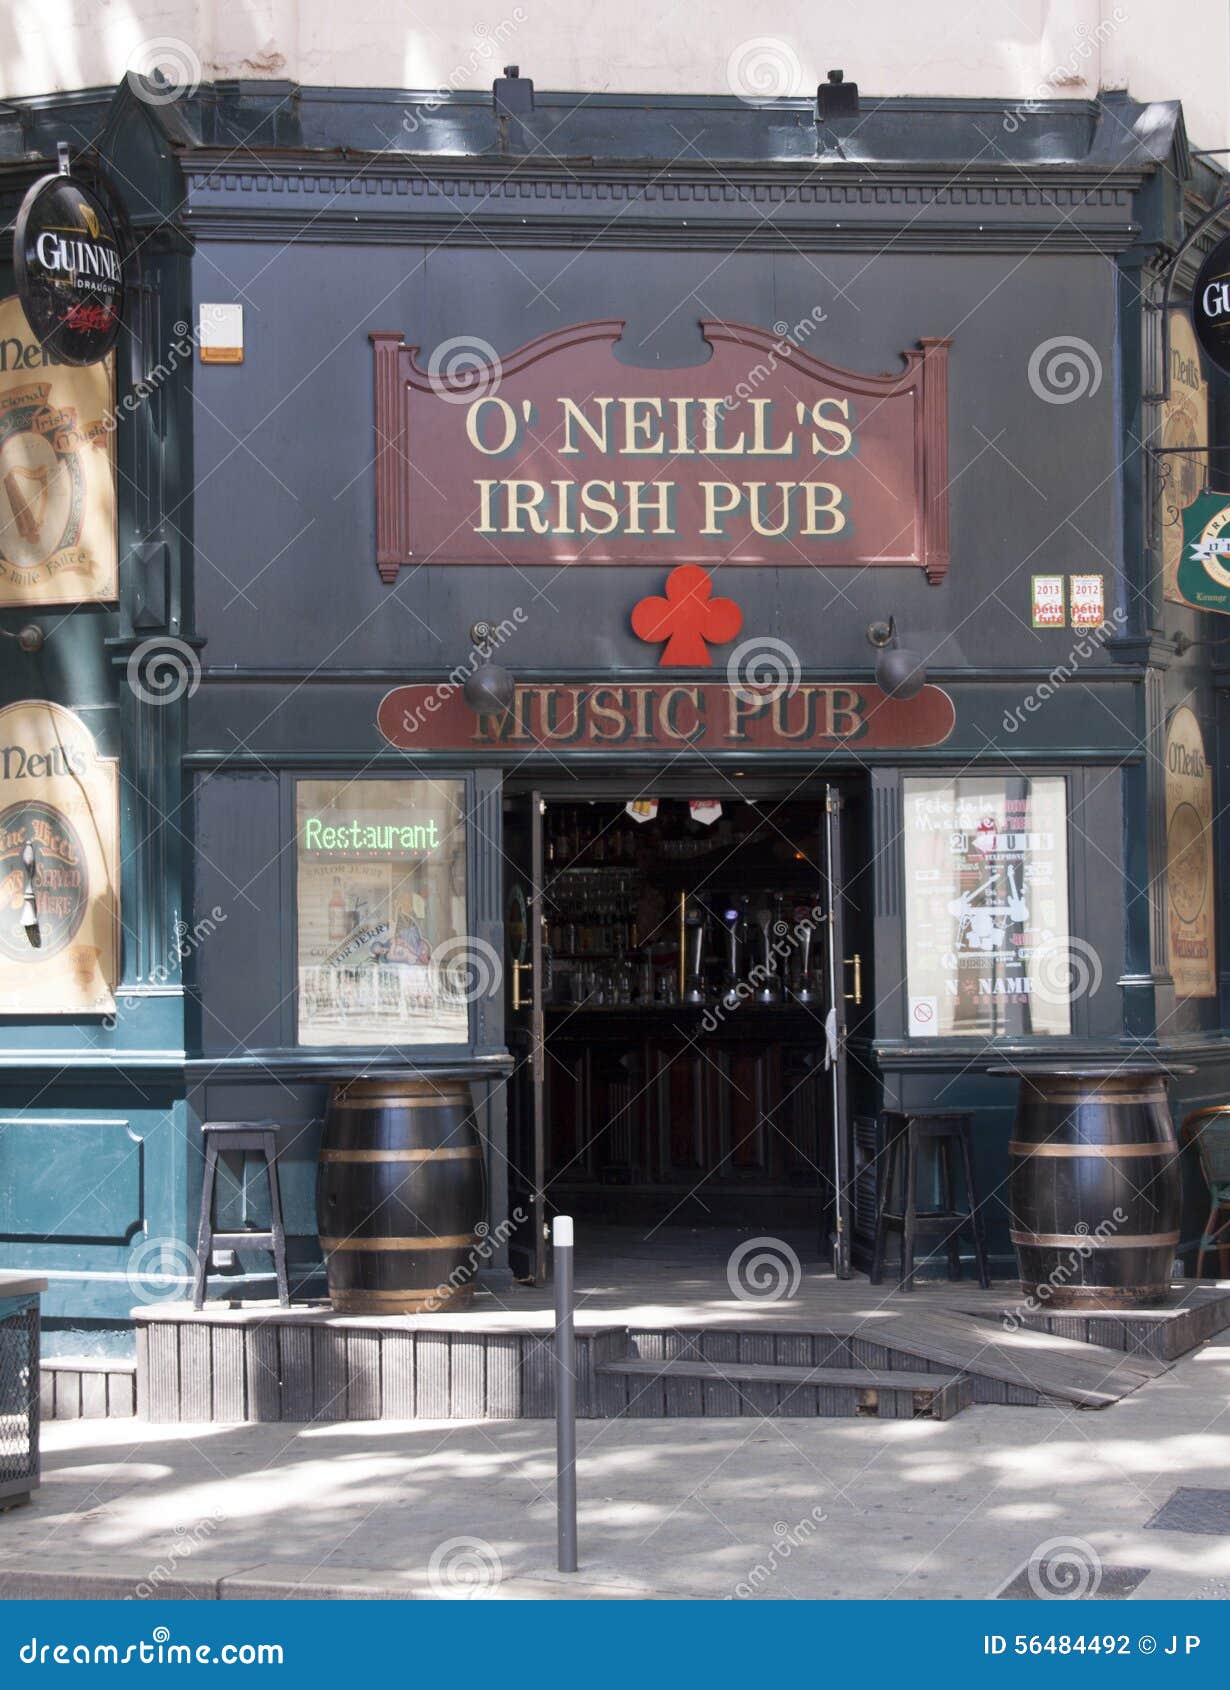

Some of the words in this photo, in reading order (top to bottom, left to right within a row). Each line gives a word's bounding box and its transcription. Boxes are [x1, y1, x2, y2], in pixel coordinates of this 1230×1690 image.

[77, 278, 115, 294] DRAUGHT
[466, 396, 531, 455] O'
[557, 396, 853, 456] NEILL'S
[472, 479, 676, 535] IRISH
[698, 481, 849, 537] PUB
[1037, 585, 1060, 595] 2013
[1075, 585, 1099, 595] 2012
[471, 687, 704, 742] MUSIC
[722, 686, 866, 739] PUB
[306, 818, 440, 850] Restaurant
